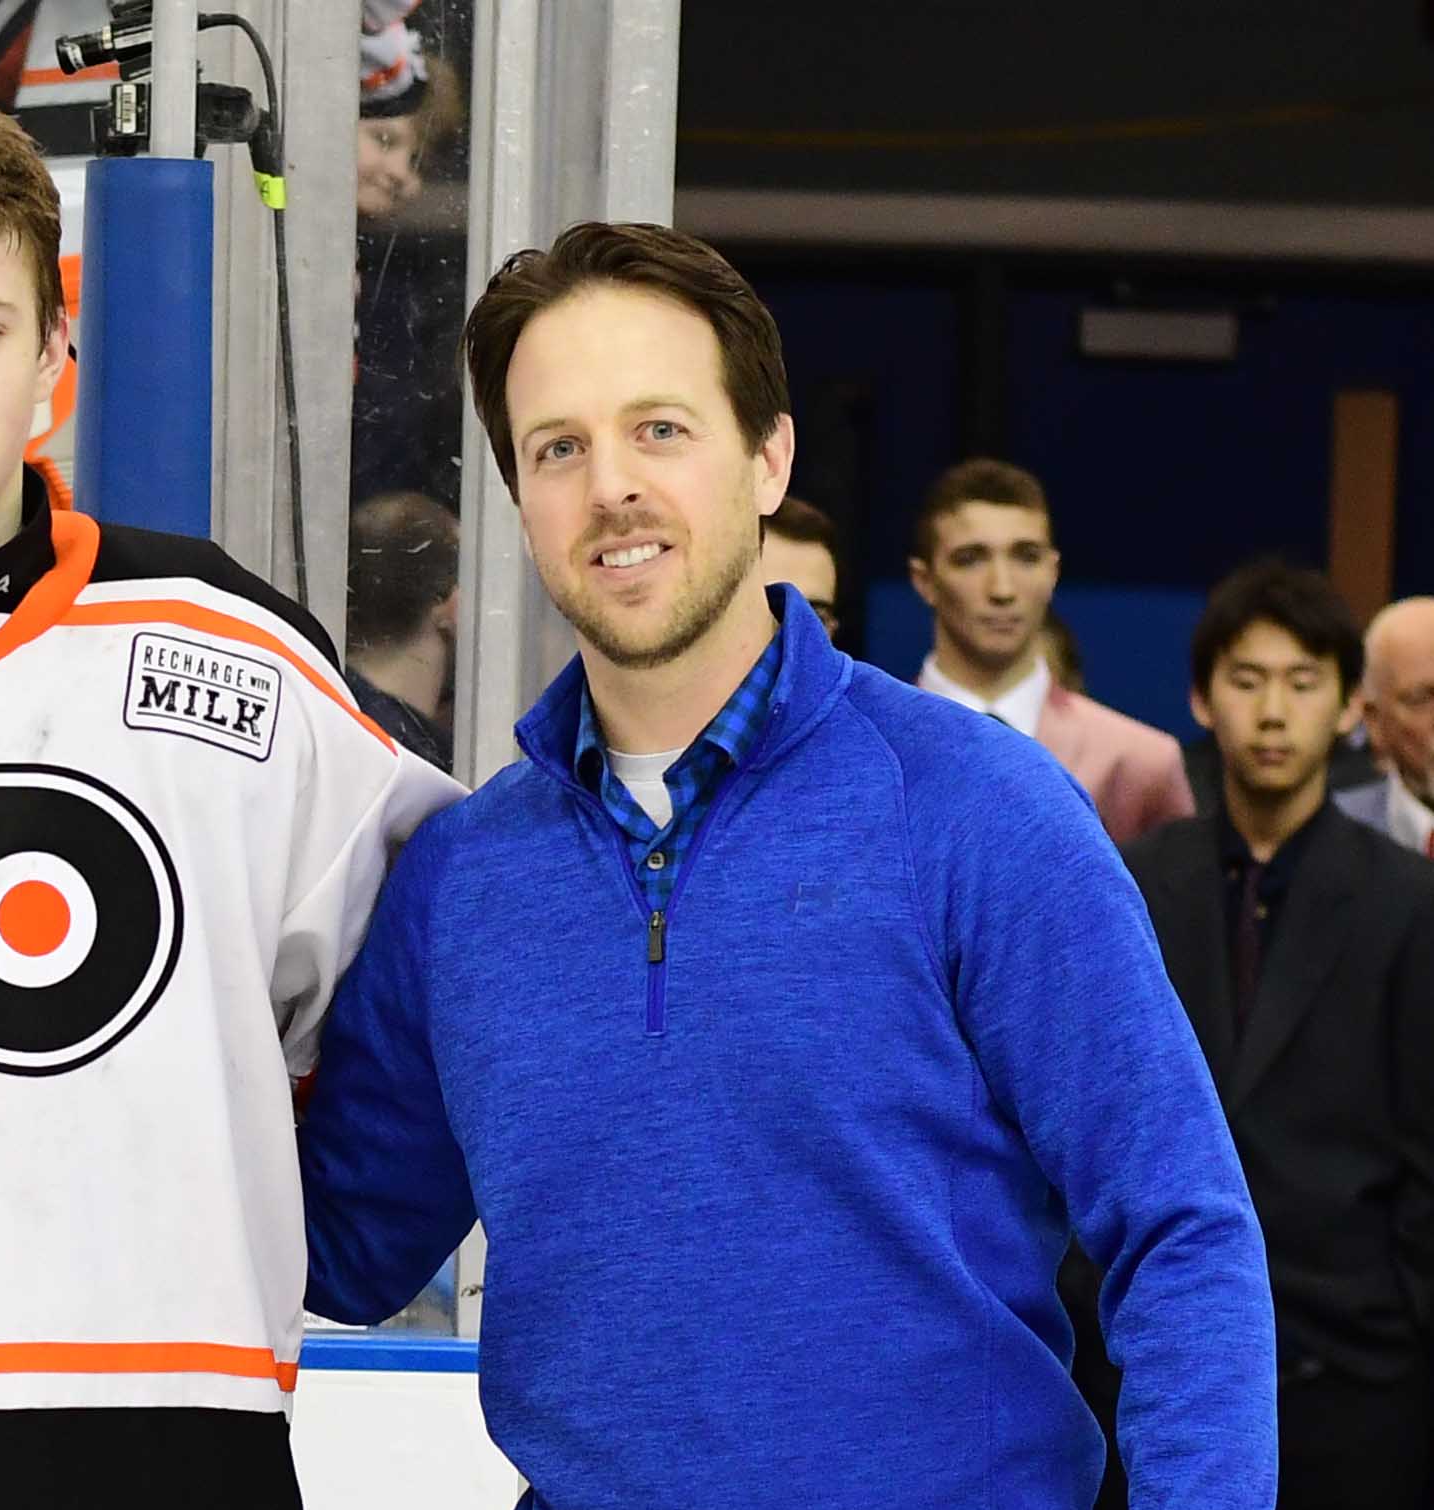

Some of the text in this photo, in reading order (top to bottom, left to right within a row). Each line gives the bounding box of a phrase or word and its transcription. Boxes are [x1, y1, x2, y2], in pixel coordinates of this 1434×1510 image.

[144, 645, 271, 692] RECHARGE WITH
[138, 675, 266, 739] MILK
